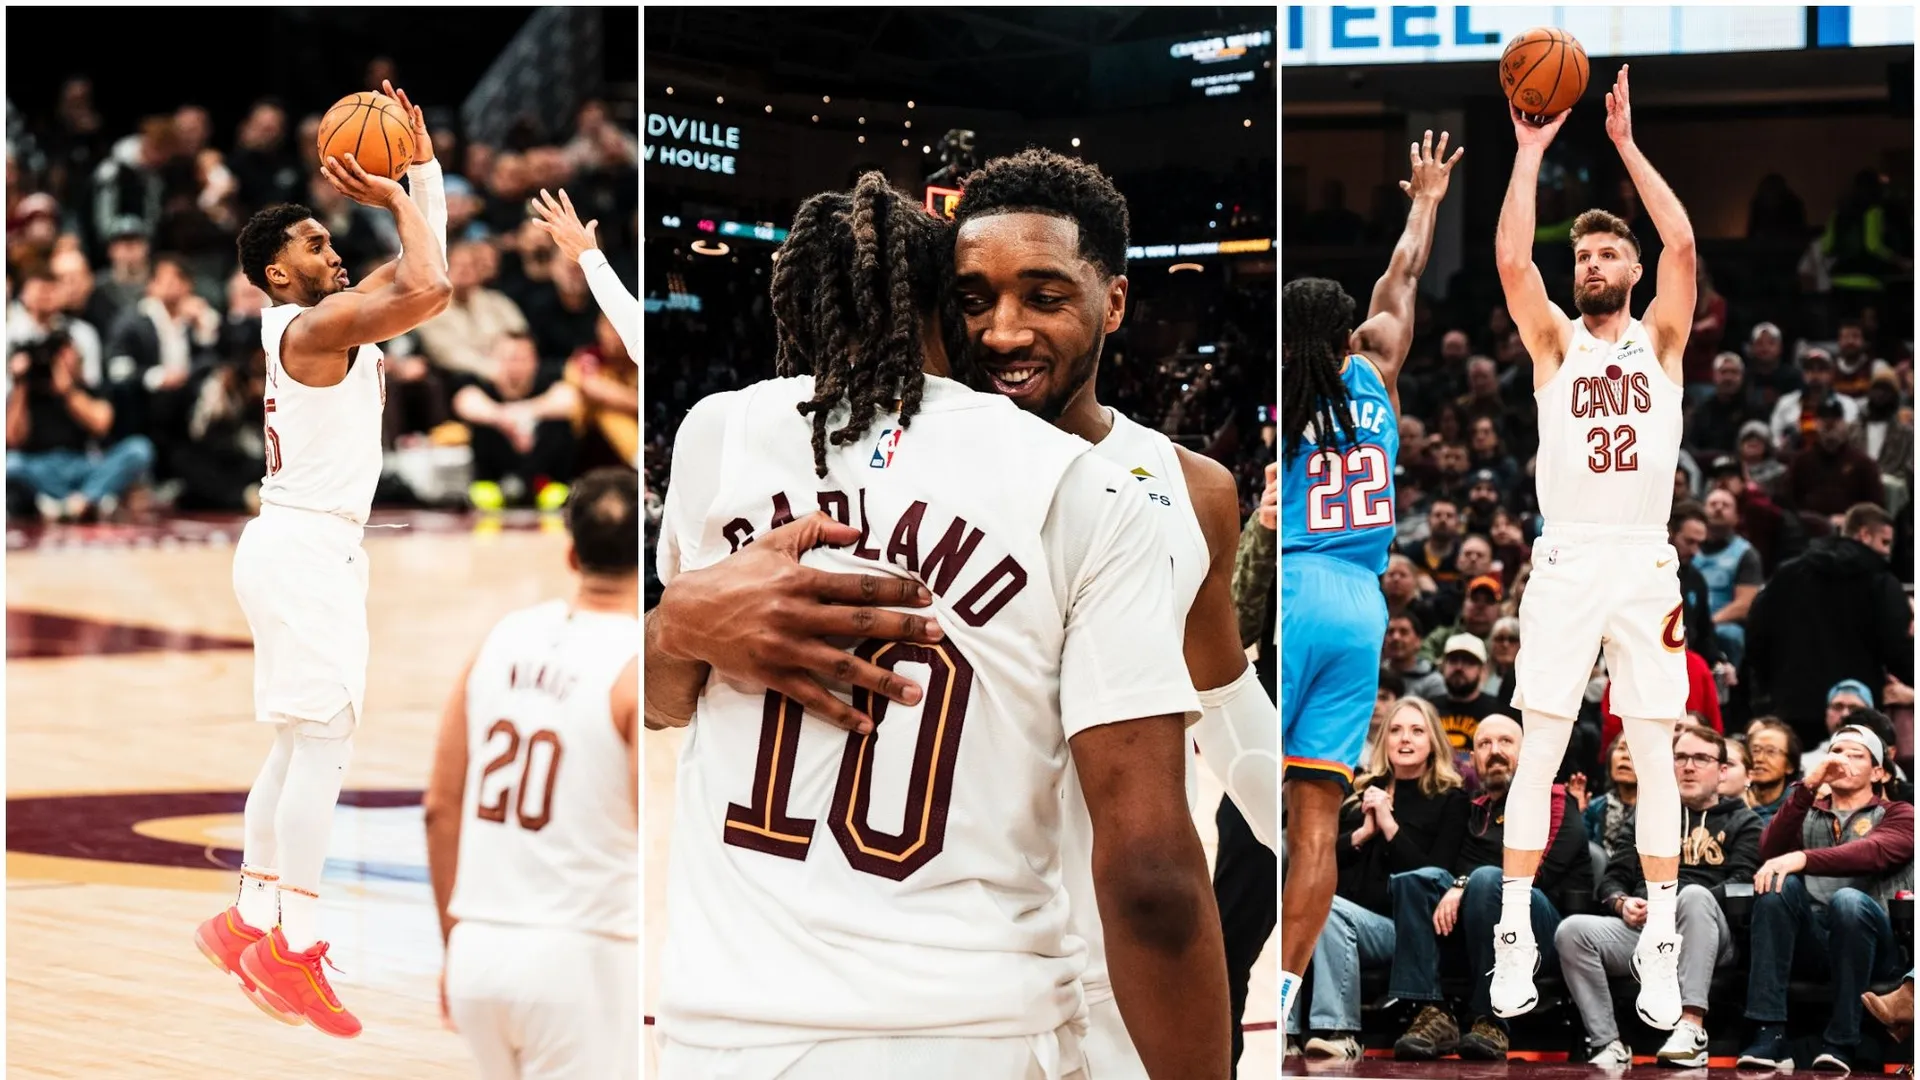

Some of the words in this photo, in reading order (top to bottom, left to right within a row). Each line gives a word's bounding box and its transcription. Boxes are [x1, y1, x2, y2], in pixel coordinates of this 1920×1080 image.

[644, 112, 740, 150] DVILLE
[660, 145, 736, 175] HOUSE
[1617, 346, 1644, 360] CLIFFS
[1571, 371, 1652, 418] CAVS
[1587, 424, 1638, 474] 32
[1307, 443, 1394, 533] 22
[477, 717, 563, 832] 20
[723, 632, 974, 882] 10
